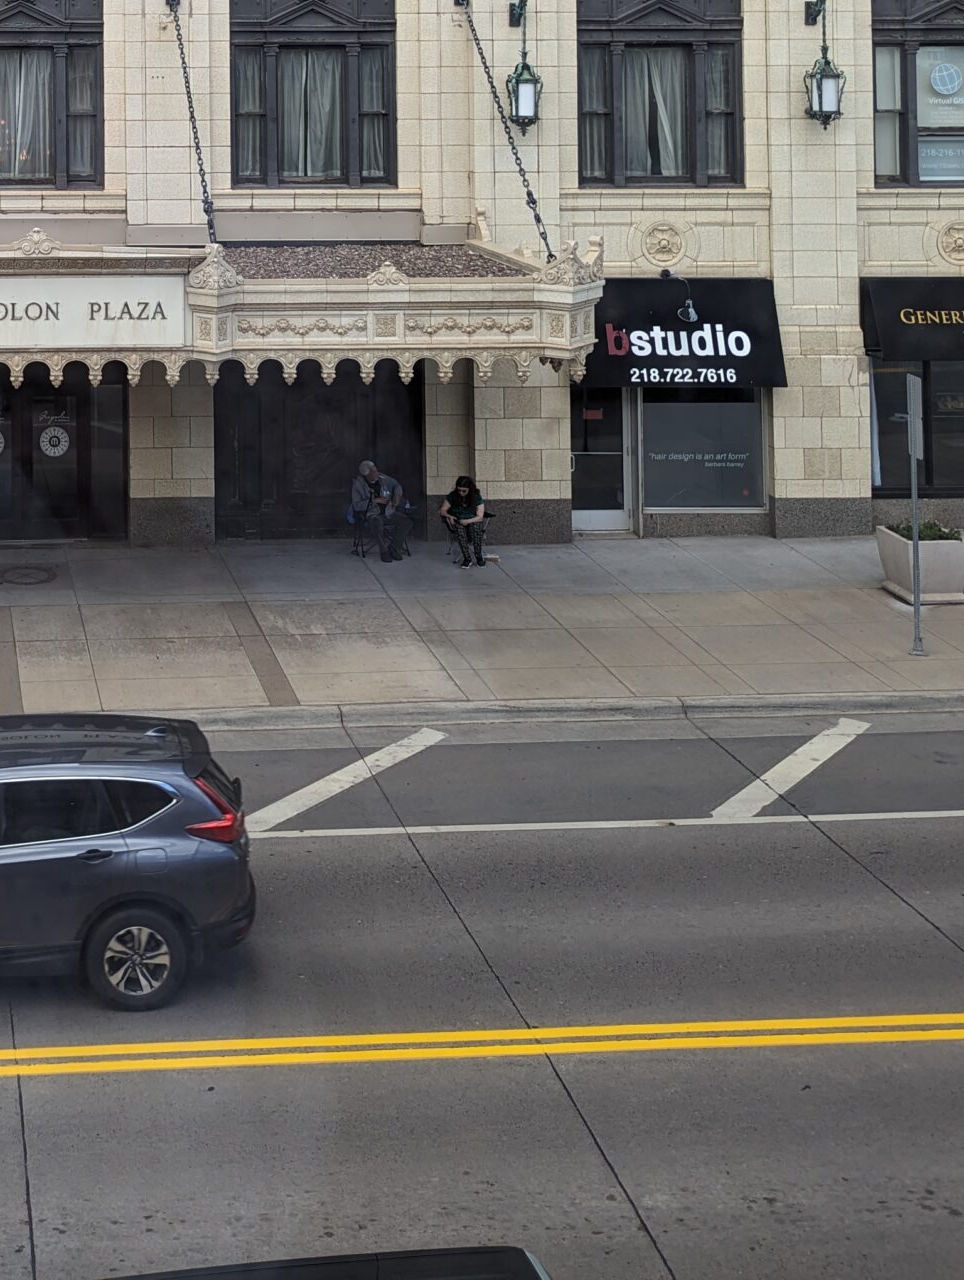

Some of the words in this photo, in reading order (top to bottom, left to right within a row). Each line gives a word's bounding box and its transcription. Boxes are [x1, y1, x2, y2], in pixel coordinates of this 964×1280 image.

[929, 97, 953, 105] Virtual
[88, 301, 168, 321] PLAZA
[900, 308, 964, 325] GENER
[605, 323, 752, 357] bstudio
[630, 368, 737, 383] 218.722.7616
[668, 452, 695, 462] design
[696, 452, 702, 460] is
